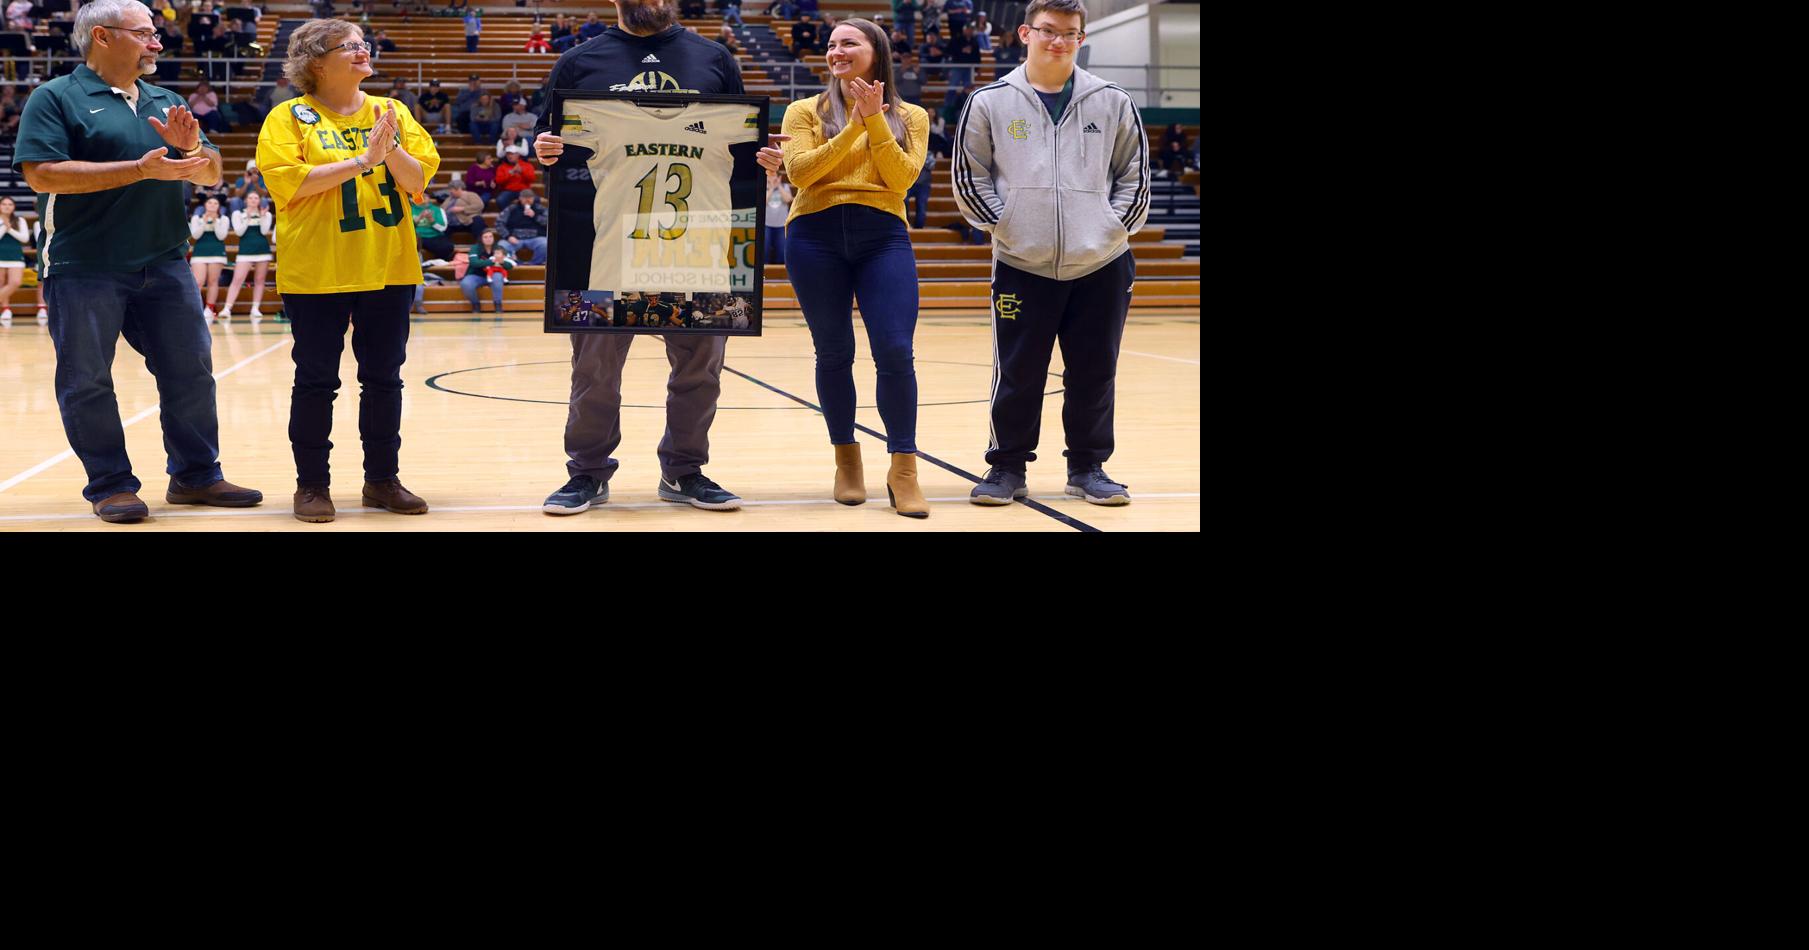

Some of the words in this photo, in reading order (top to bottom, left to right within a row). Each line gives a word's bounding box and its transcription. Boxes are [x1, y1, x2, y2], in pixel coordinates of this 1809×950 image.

[624, 143, 704, 160] EASTERN
[339, 160, 404, 233] 13
[627, 163, 693, 240] 13
